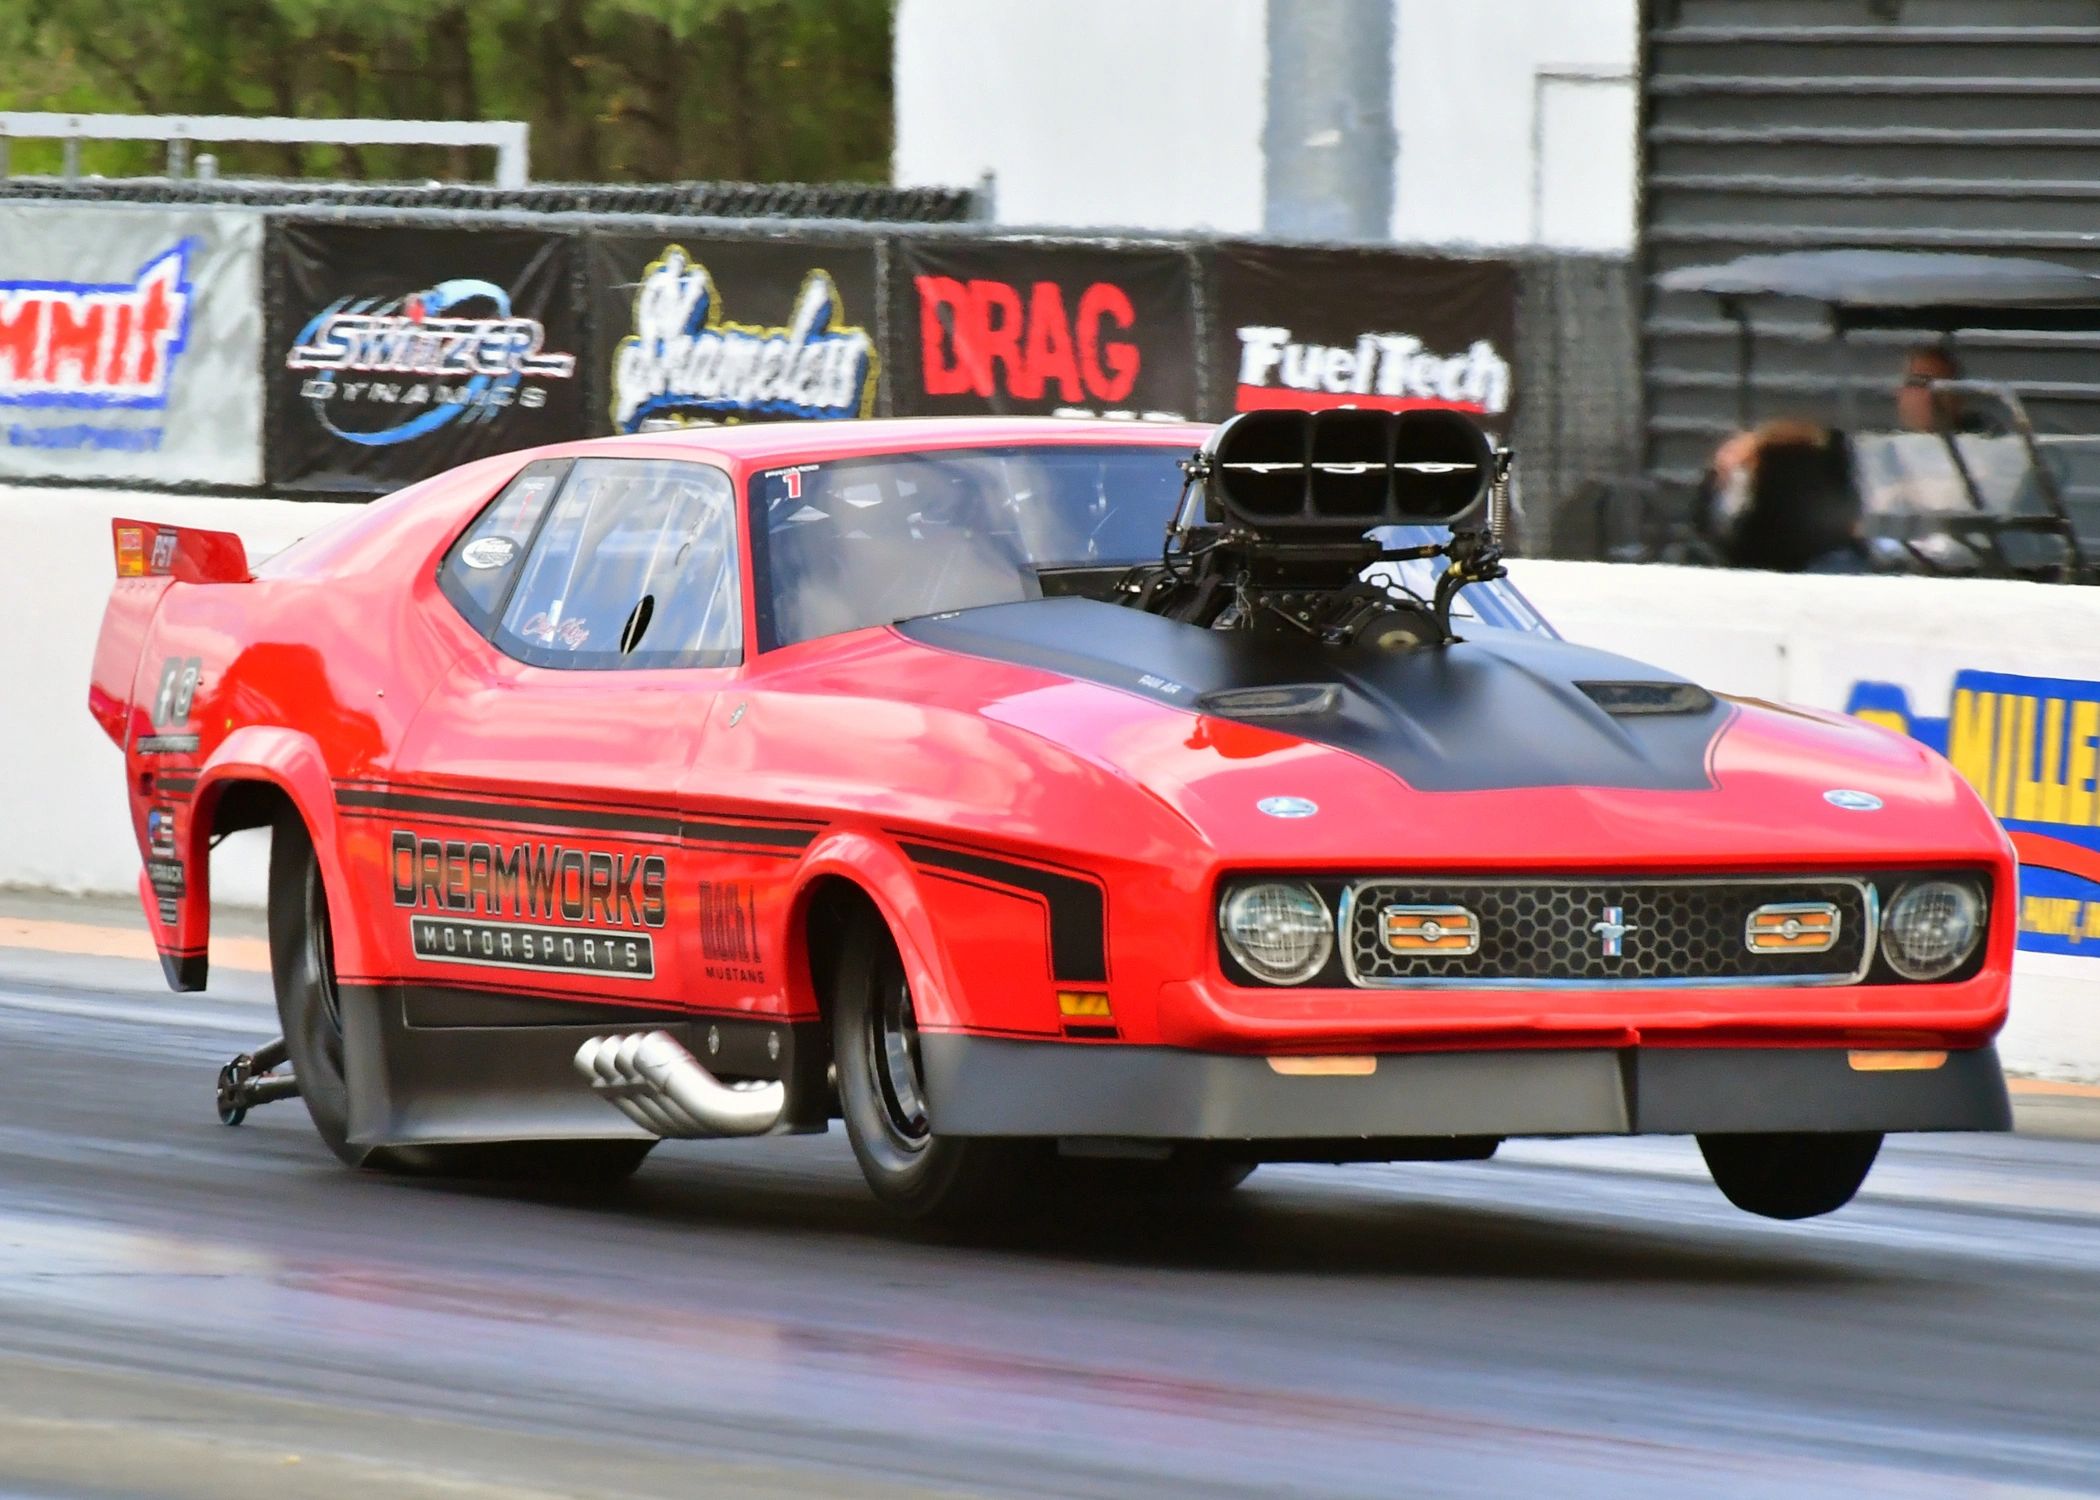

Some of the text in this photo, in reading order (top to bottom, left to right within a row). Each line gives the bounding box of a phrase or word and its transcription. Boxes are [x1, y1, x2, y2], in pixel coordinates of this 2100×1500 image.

[915, 276, 1141, 401] DRAG
[1237, 325, 1512, 413] FuelTech
[391, 829, 667, 928] DREAMWORKS
[423, 926, 640, 968] MOTORSPORTS
